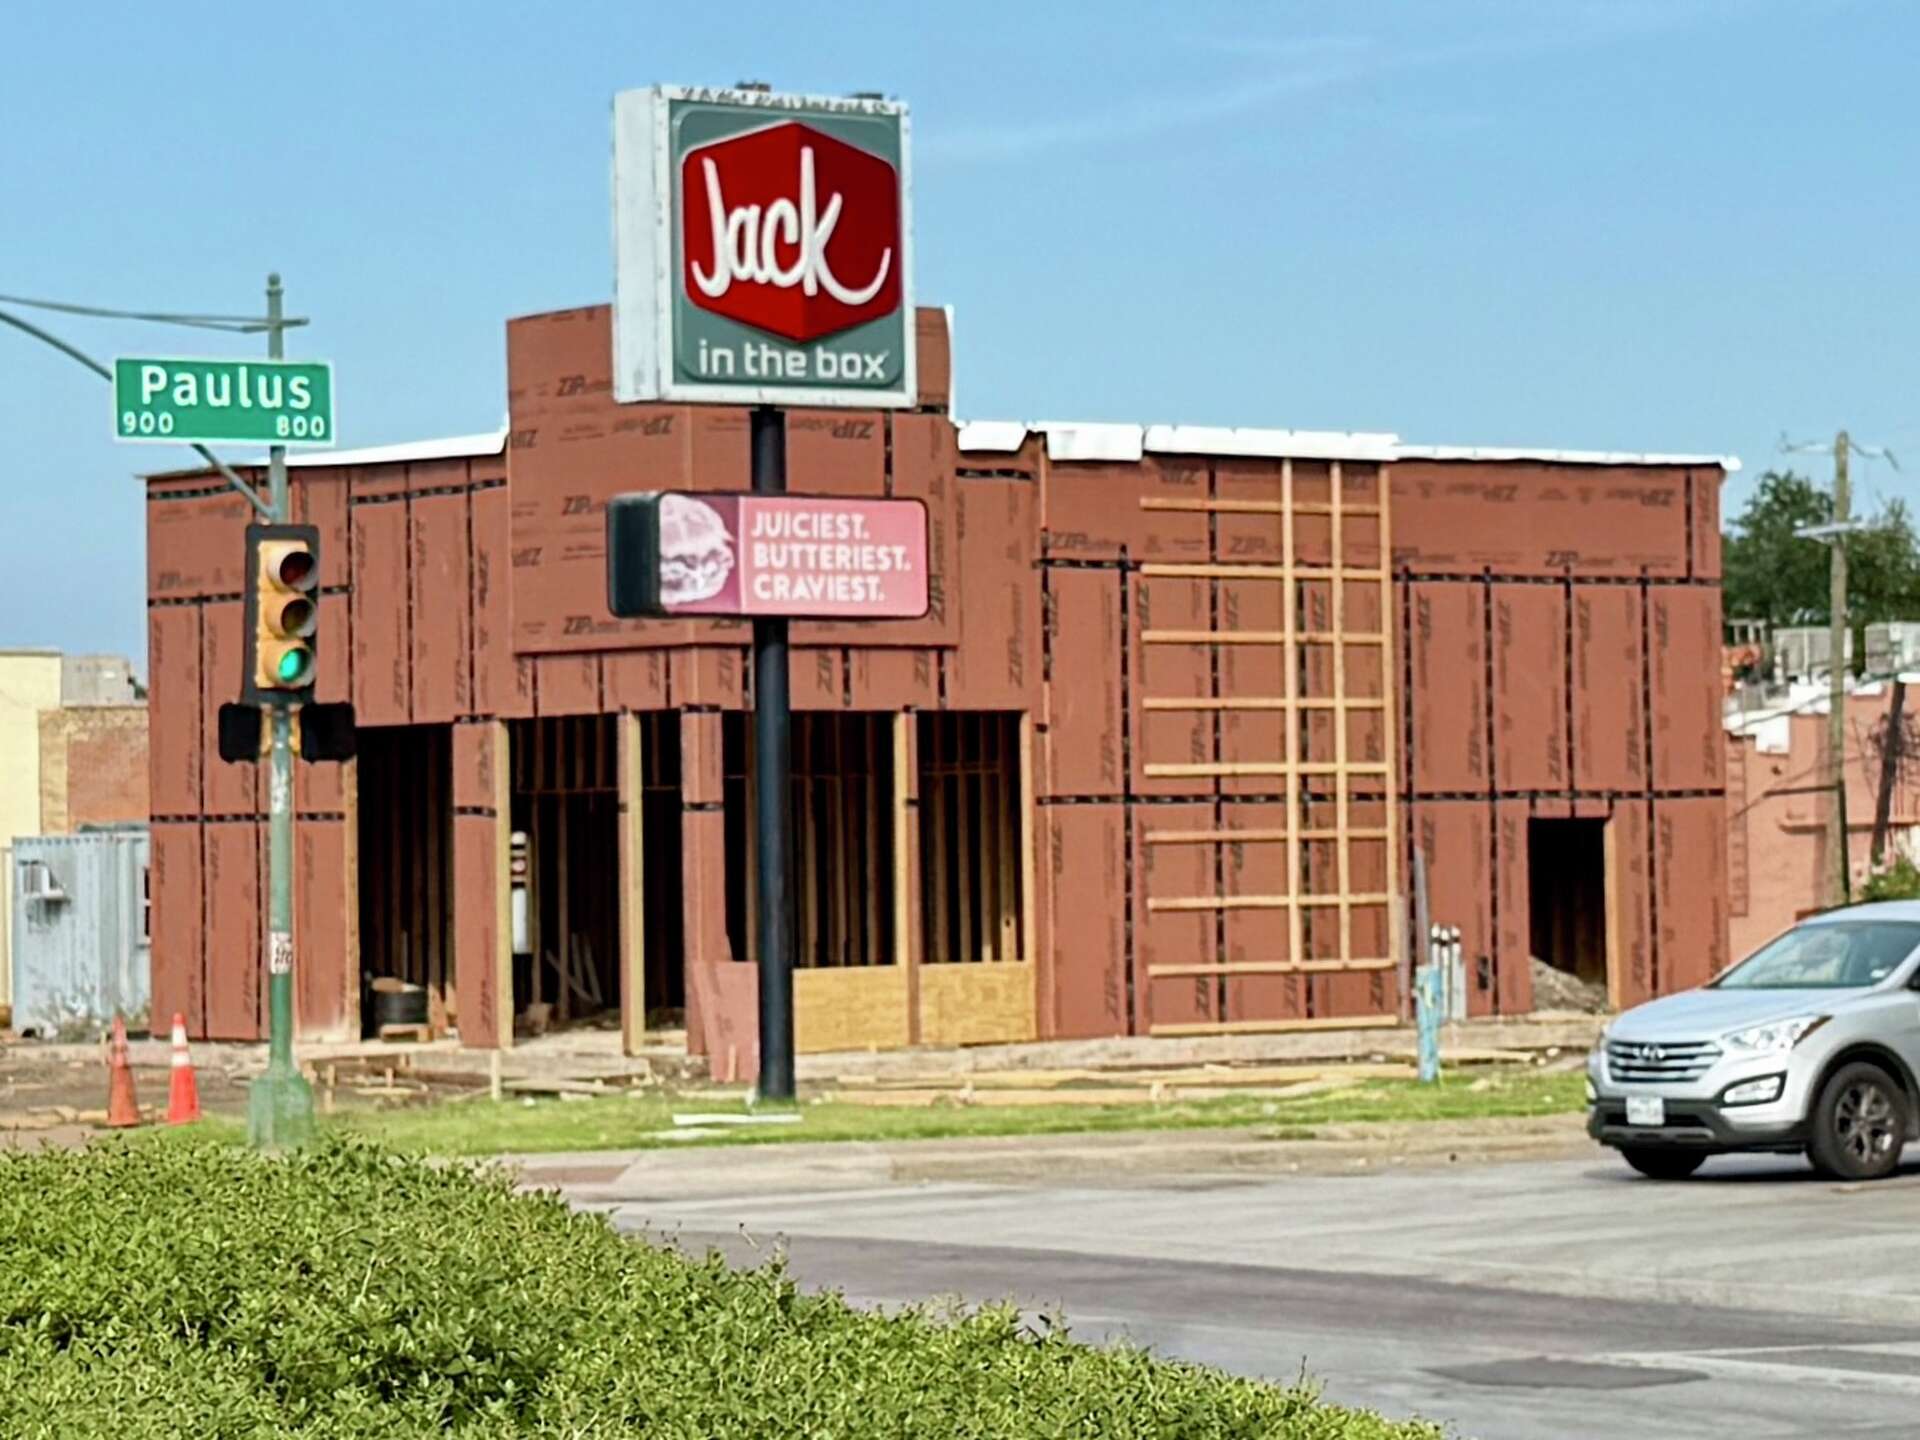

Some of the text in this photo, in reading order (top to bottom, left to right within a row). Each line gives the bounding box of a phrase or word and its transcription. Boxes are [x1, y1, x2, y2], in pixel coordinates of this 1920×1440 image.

[691, 146, 891, 305] Jack
[699, 339, 889, 380] in the box
[141, 366, 312, 410] Paulus
[123, 411, 325, 437] 900 800
[833, 421, 875, 439] ZIP
[751, 511, 869, 540] JUICIEST.
[753, 542, 912, 575] BUTTERIEST.
[753, 573, 886, 604] CRAVIEST.
